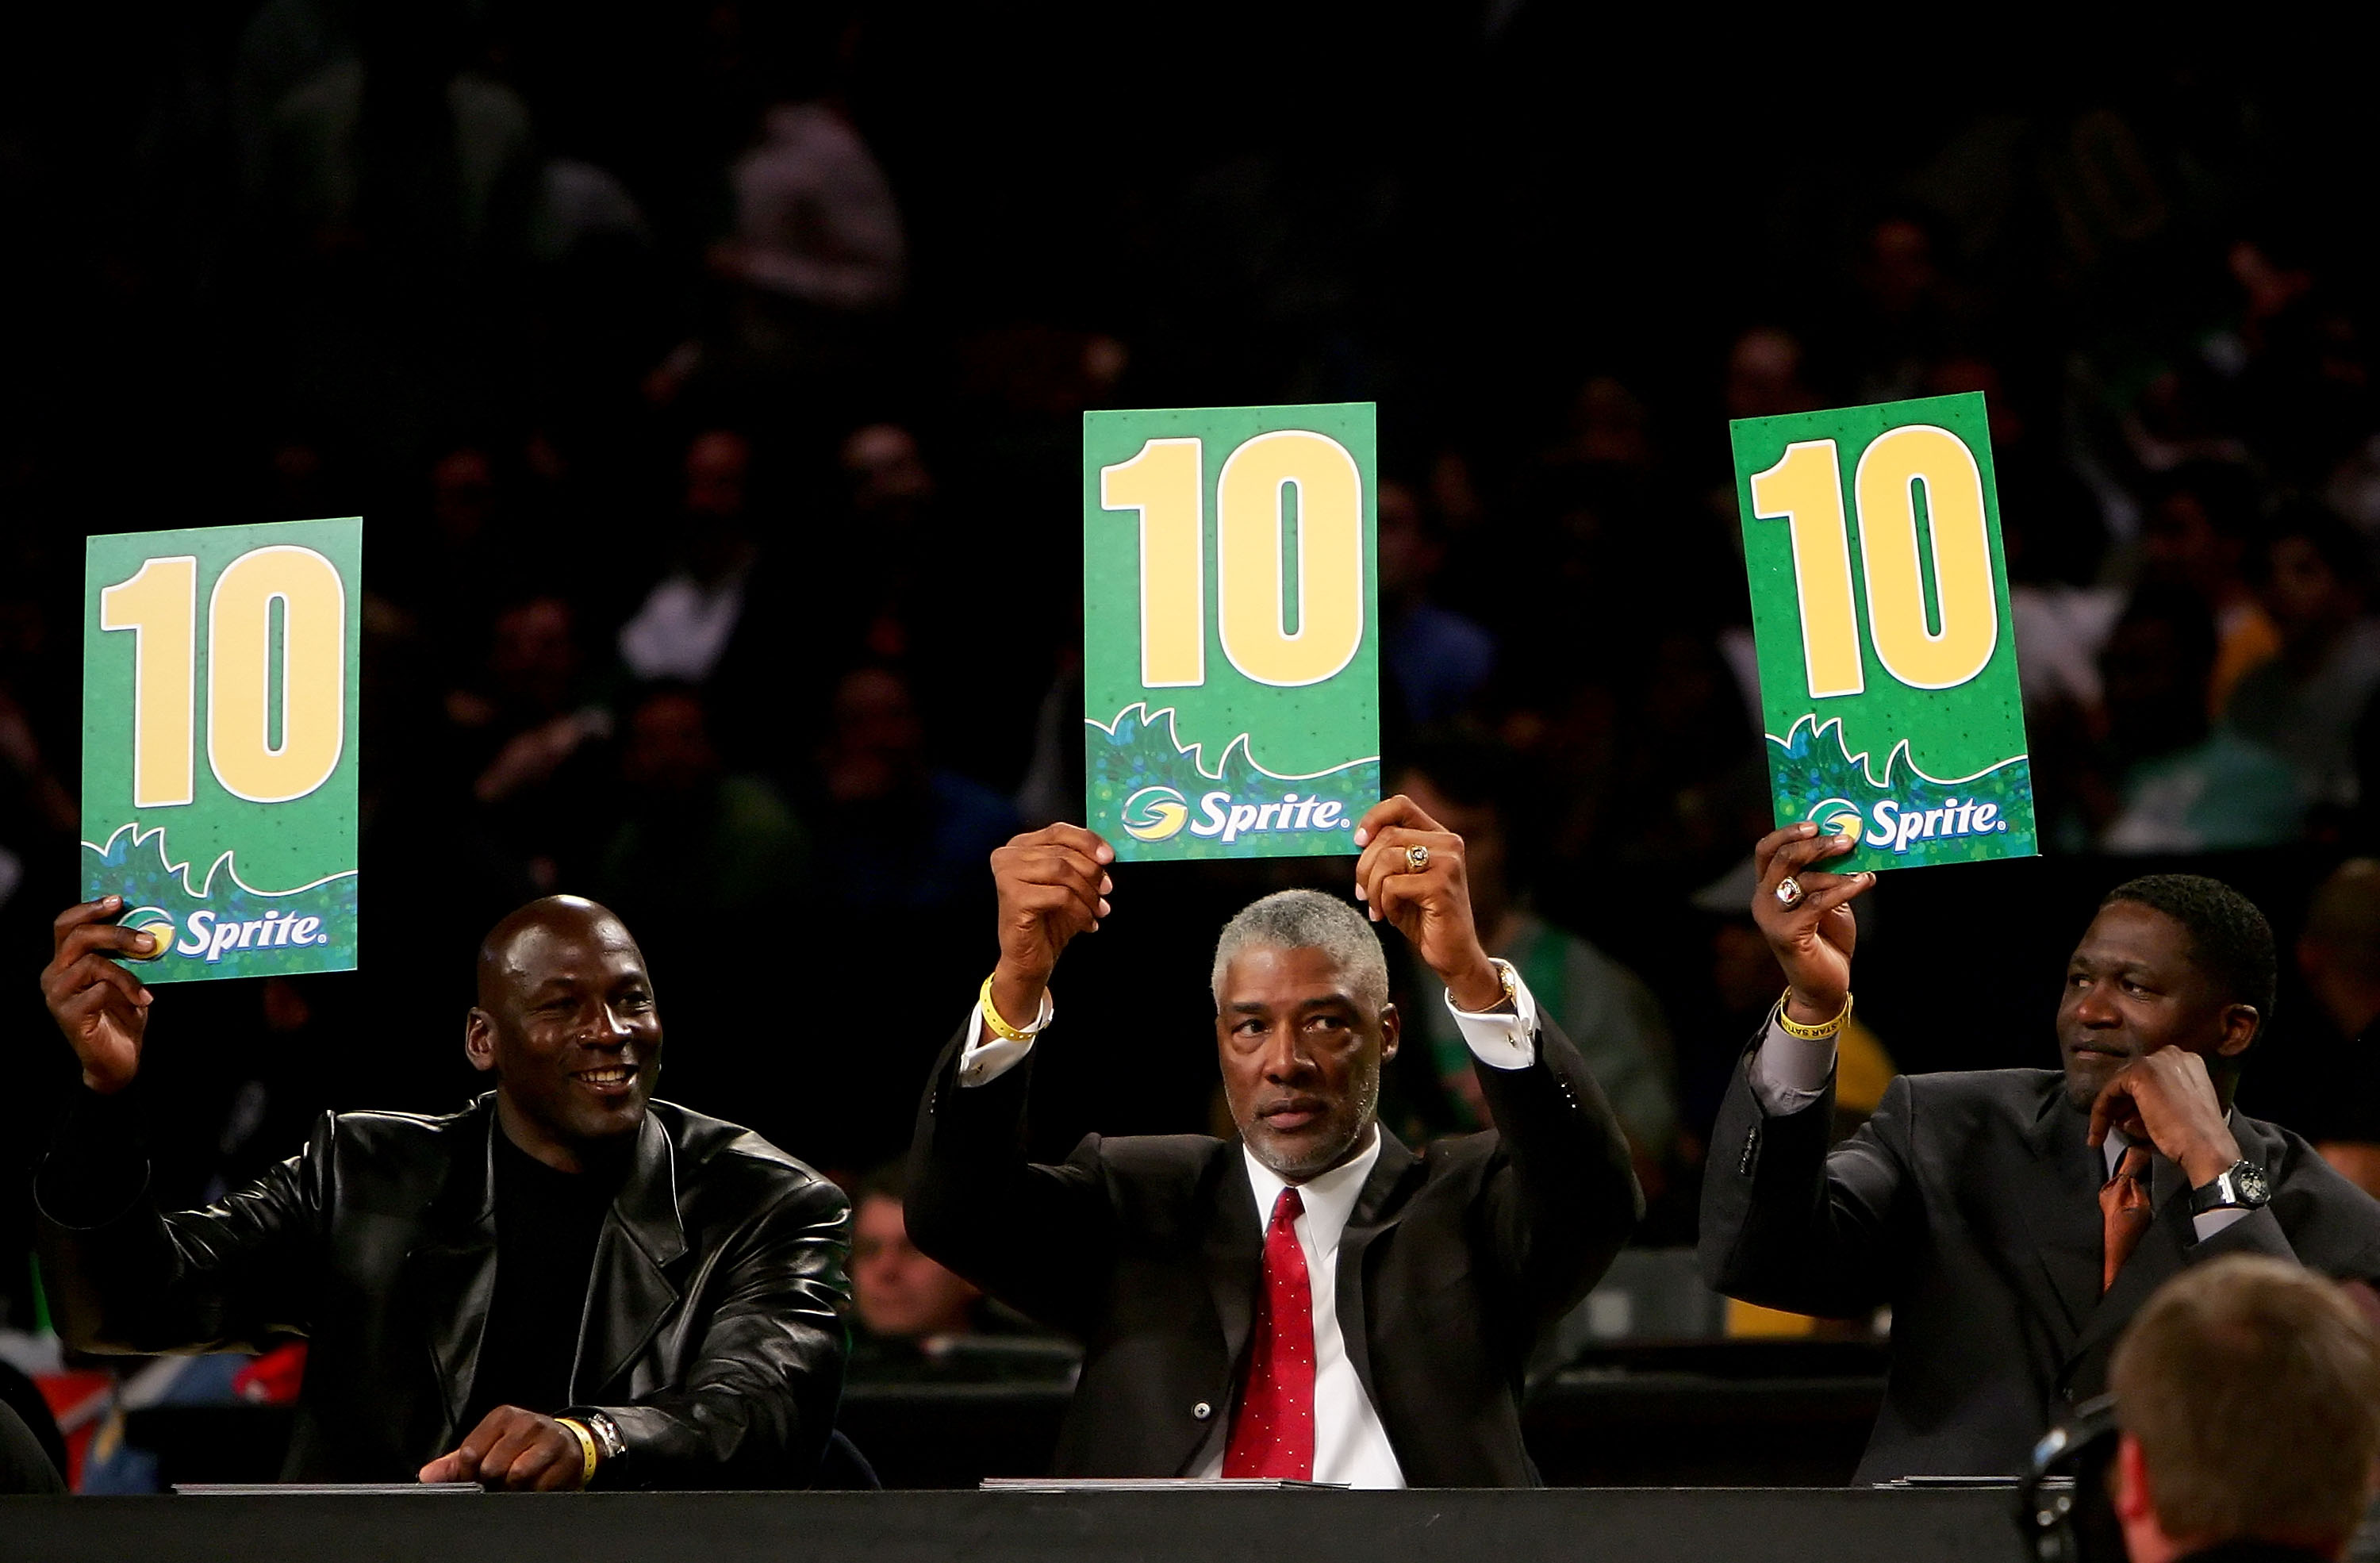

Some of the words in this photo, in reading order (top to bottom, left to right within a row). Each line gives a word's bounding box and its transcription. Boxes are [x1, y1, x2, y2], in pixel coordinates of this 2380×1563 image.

[1100, 429, 1364, 688] 10
[1750, 424, 1998, 698] 10
[101, 545, 345, 808] 10
[1190, 792, 1342, 844] Sprite
[1866, 797, 1999, 854] Sprite
[177, 910, 321, 962] Sprite
[1812, 1022, 1837, 1036] STAR
